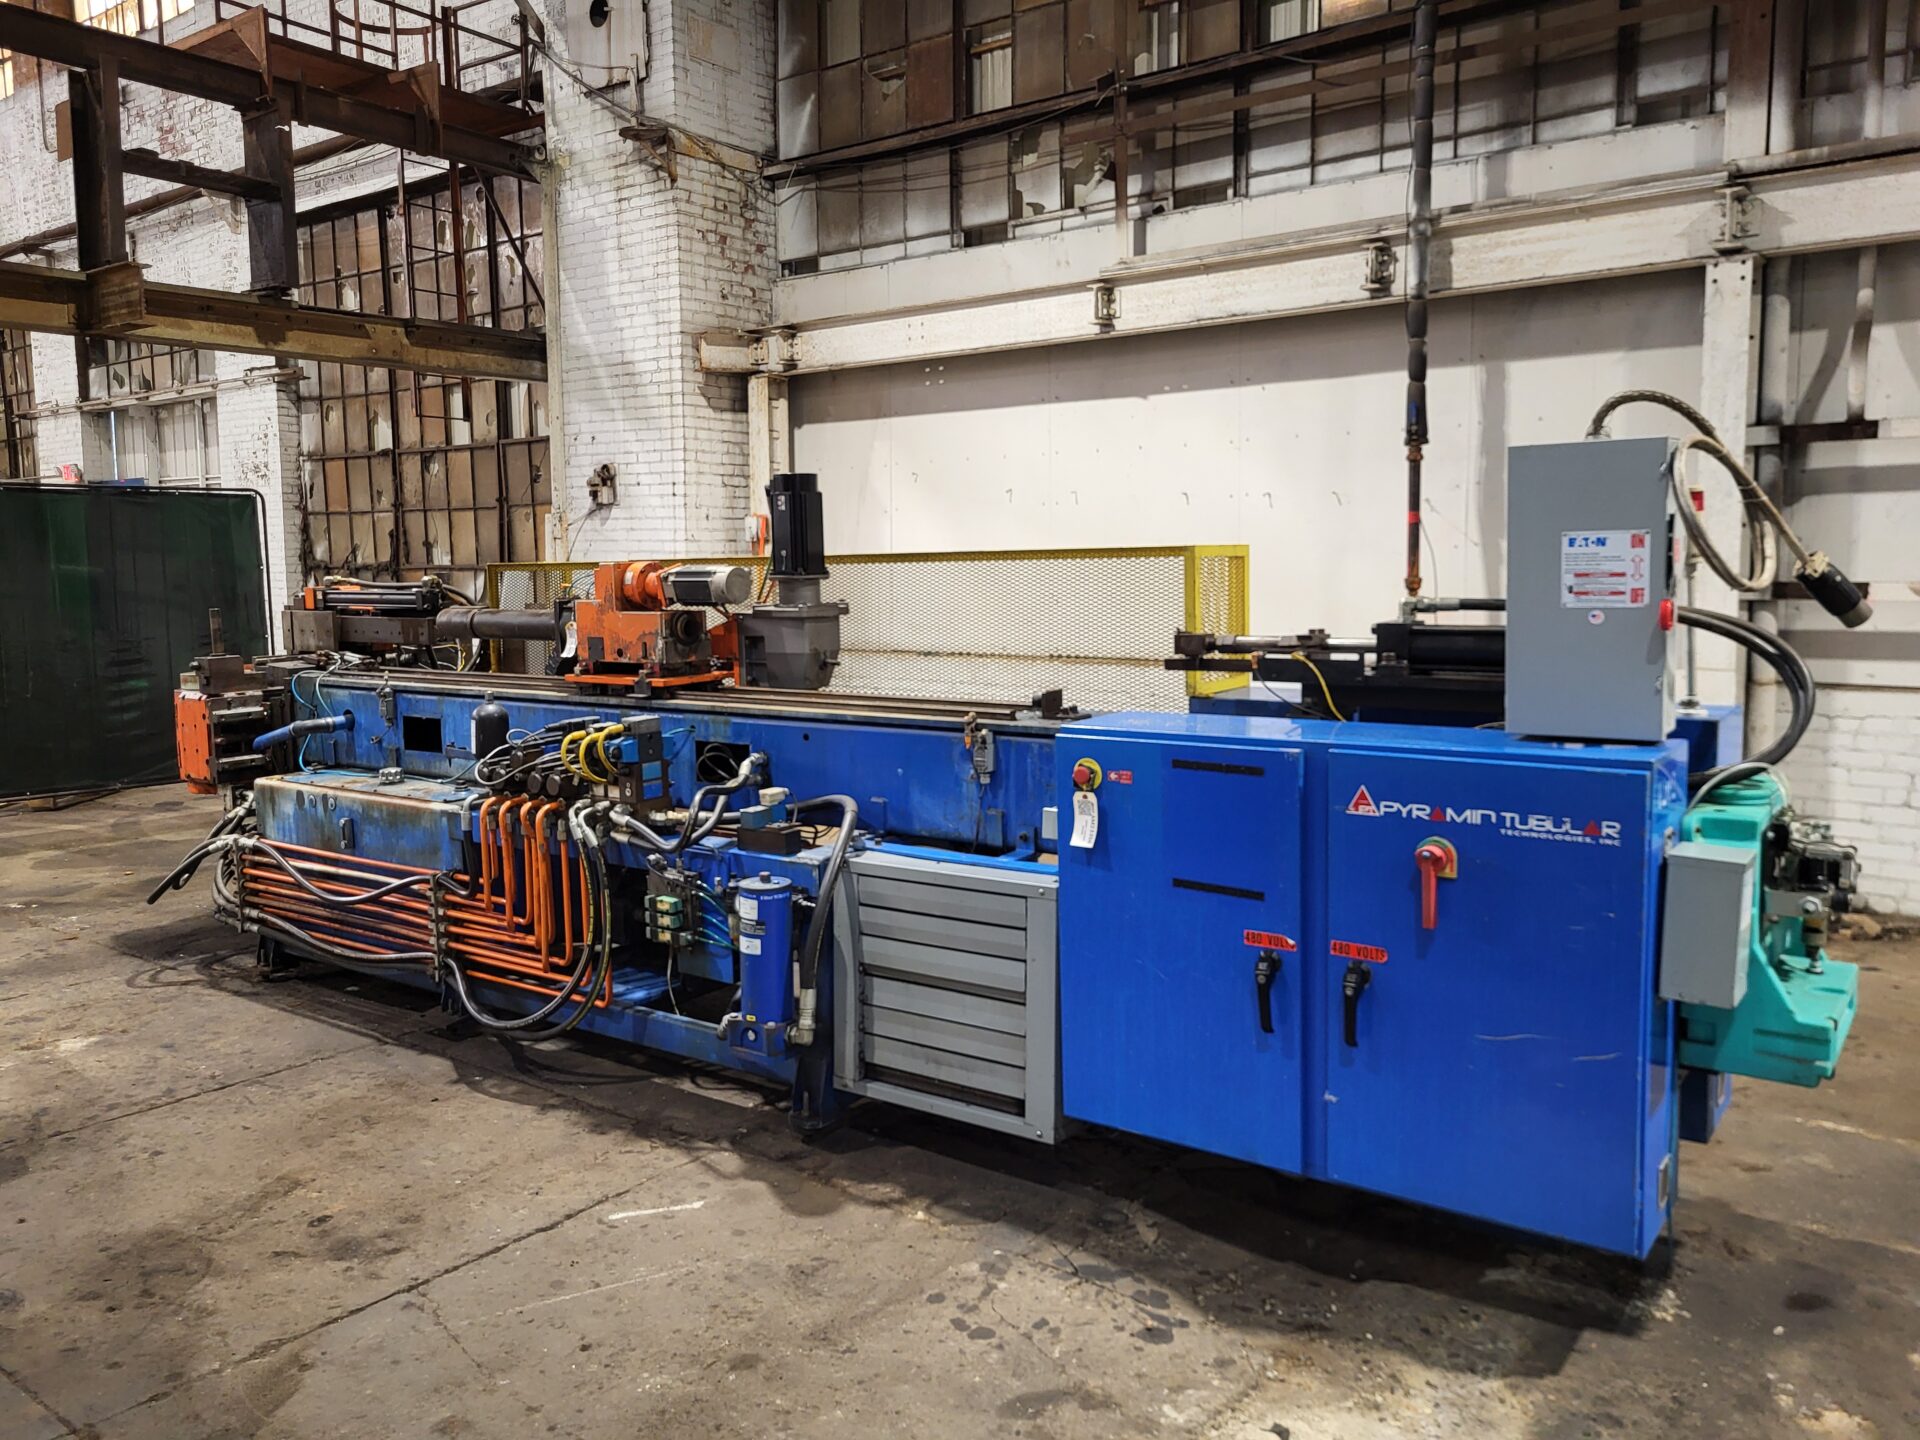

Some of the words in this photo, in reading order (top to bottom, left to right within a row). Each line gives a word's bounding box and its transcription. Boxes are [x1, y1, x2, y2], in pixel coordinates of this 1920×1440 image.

[1568, 537, 1607, 548] EATON
[1499, 811, 1622, 838] TUBULAR
[1245, 931, 1262, 944] 480
[1331, 941, 1350, 955] 480
[1356, 945, 1386, 961] VOLTS
